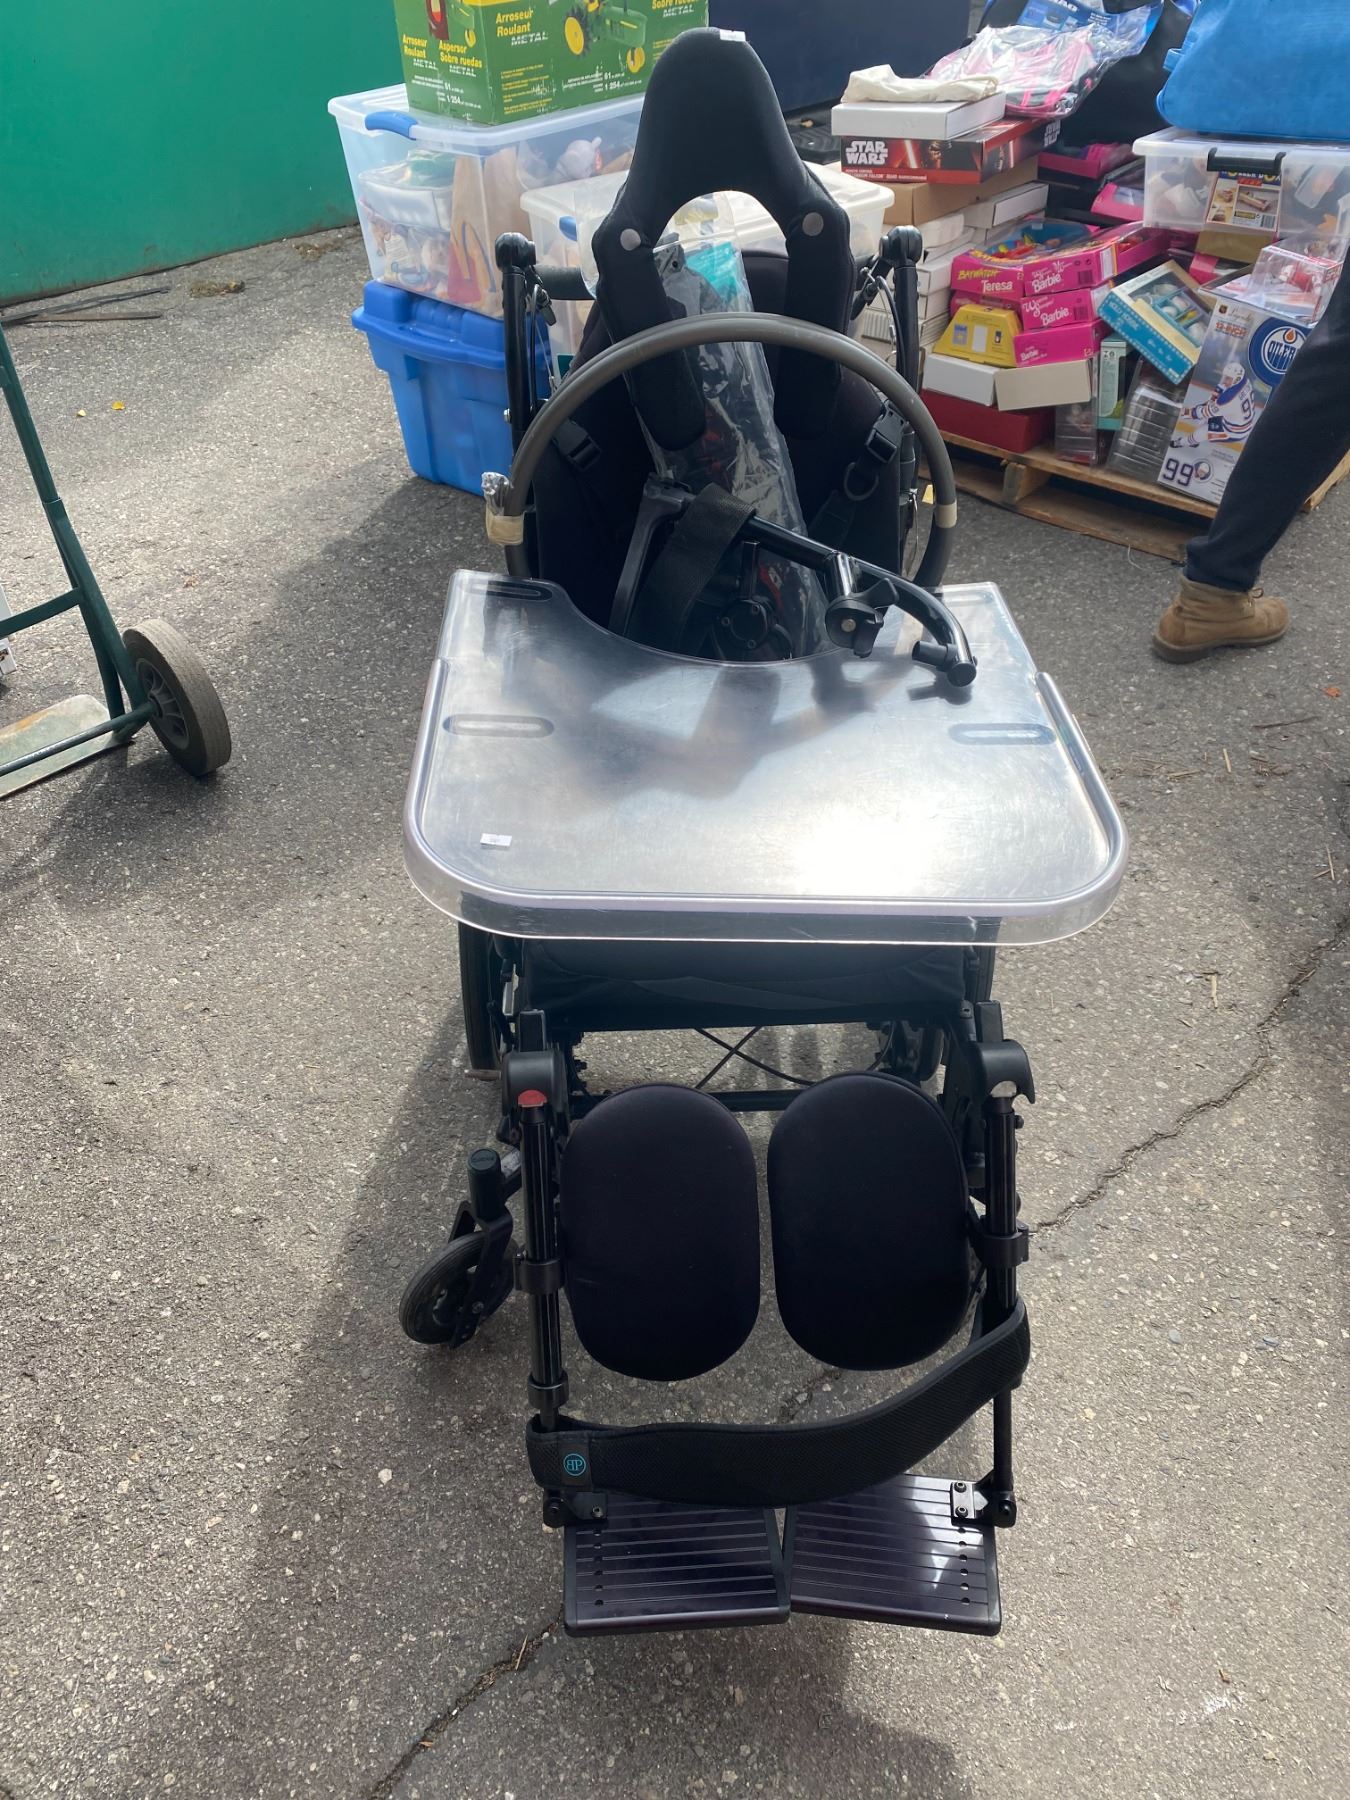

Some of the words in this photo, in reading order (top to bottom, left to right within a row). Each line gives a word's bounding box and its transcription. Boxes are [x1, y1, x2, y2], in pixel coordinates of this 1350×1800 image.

[496, 9, 533, 24] Arroseur
[497, 22, 530, 37] Roulant
[402, 34, 427, 47] Arroseur
[511, 31, 548, 45] METAL
[404, 45, 426, 58] Roulant
[439, 40, 467, 54] Aspersor
[440, 52, 458, 64] Sobre
[459, 56, 482, 68] ruedas
[845, 140, 888, 153] STAR
[845, 152, 888, 165] WARS
[981, 279, 1013, 294] Teresa
[1032, 272, 1062, 293] Barbie
[1040, 306, 1070, 326] Barbie
[1163, 458, 1194, 487] 99
